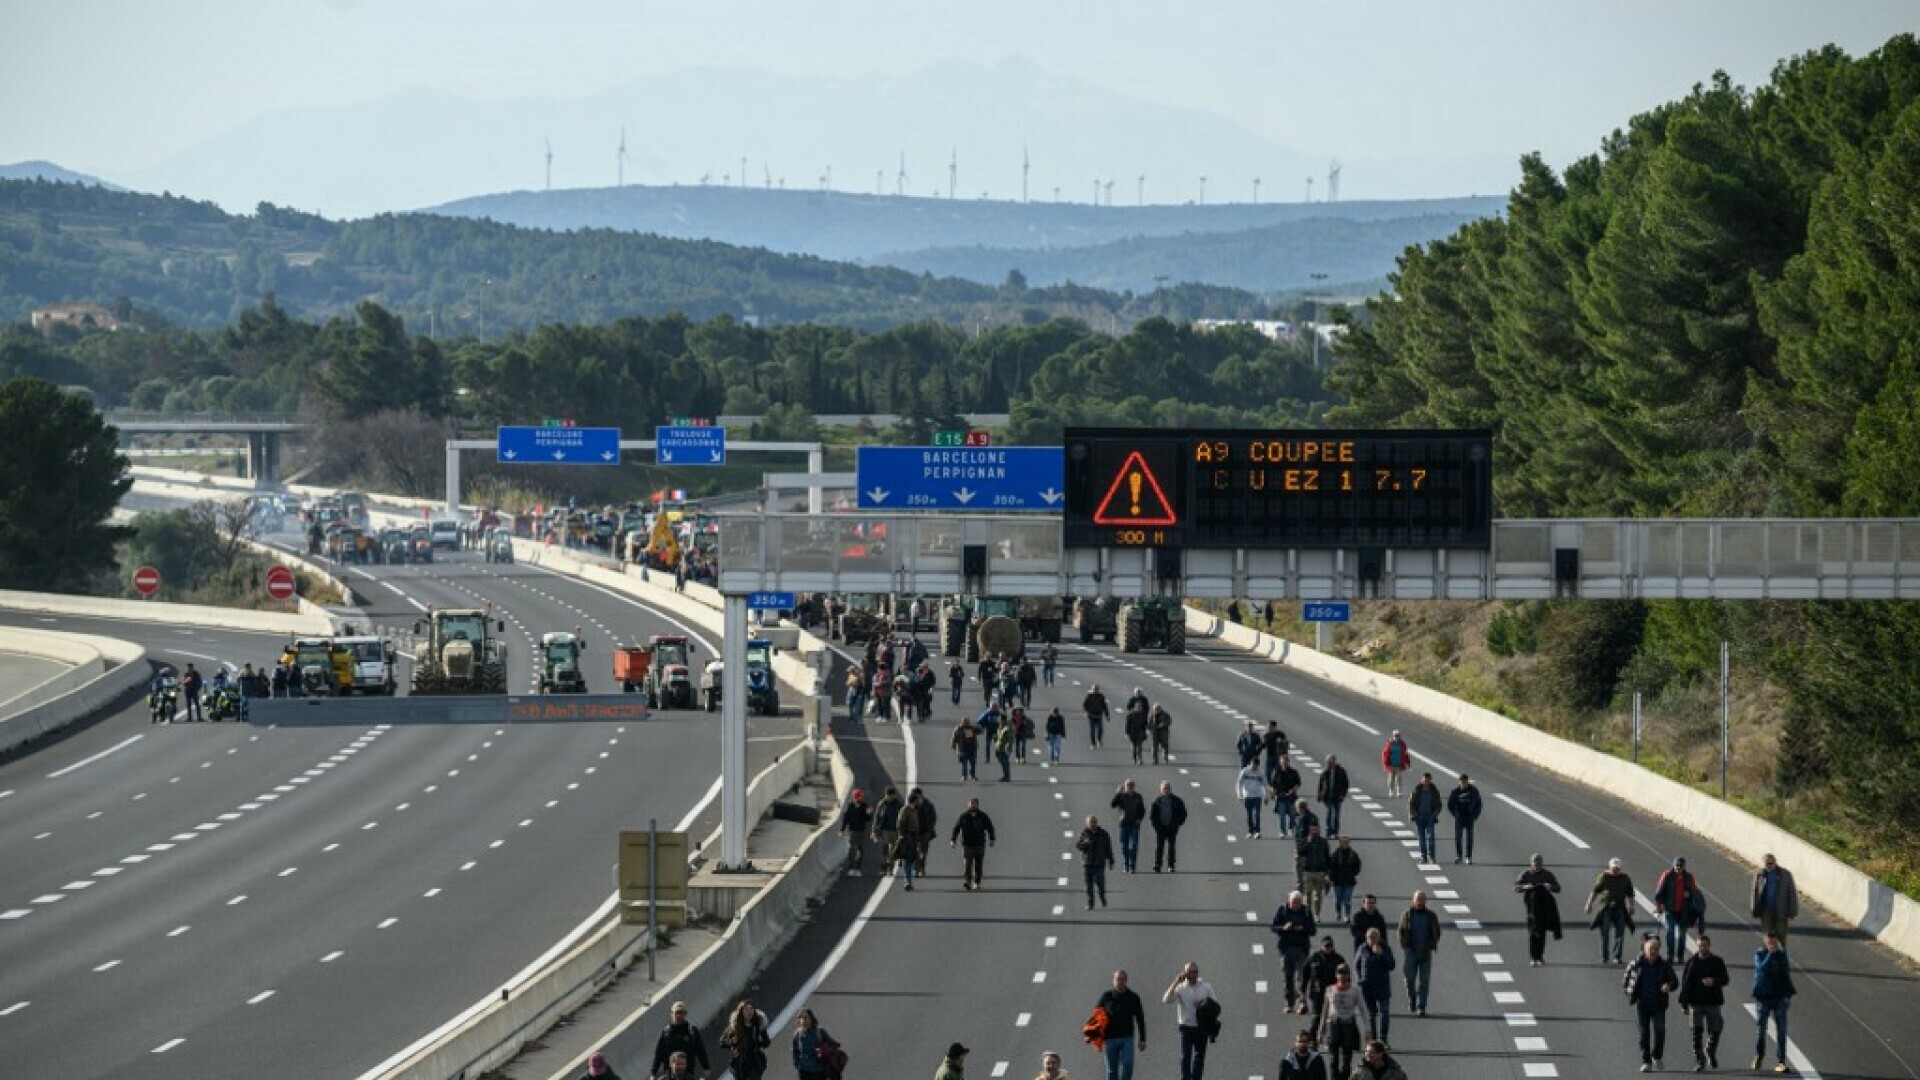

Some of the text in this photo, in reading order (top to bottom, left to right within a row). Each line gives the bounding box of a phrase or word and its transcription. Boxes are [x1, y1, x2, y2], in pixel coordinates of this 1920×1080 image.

[923, 451, 1006, 464] BARCELONE
[1196, 441, 1356, 463] A9 COUPEE
[923, 466, 1006, 479] PERPIGNAN
[1115, 530, 1145, 545] 300
